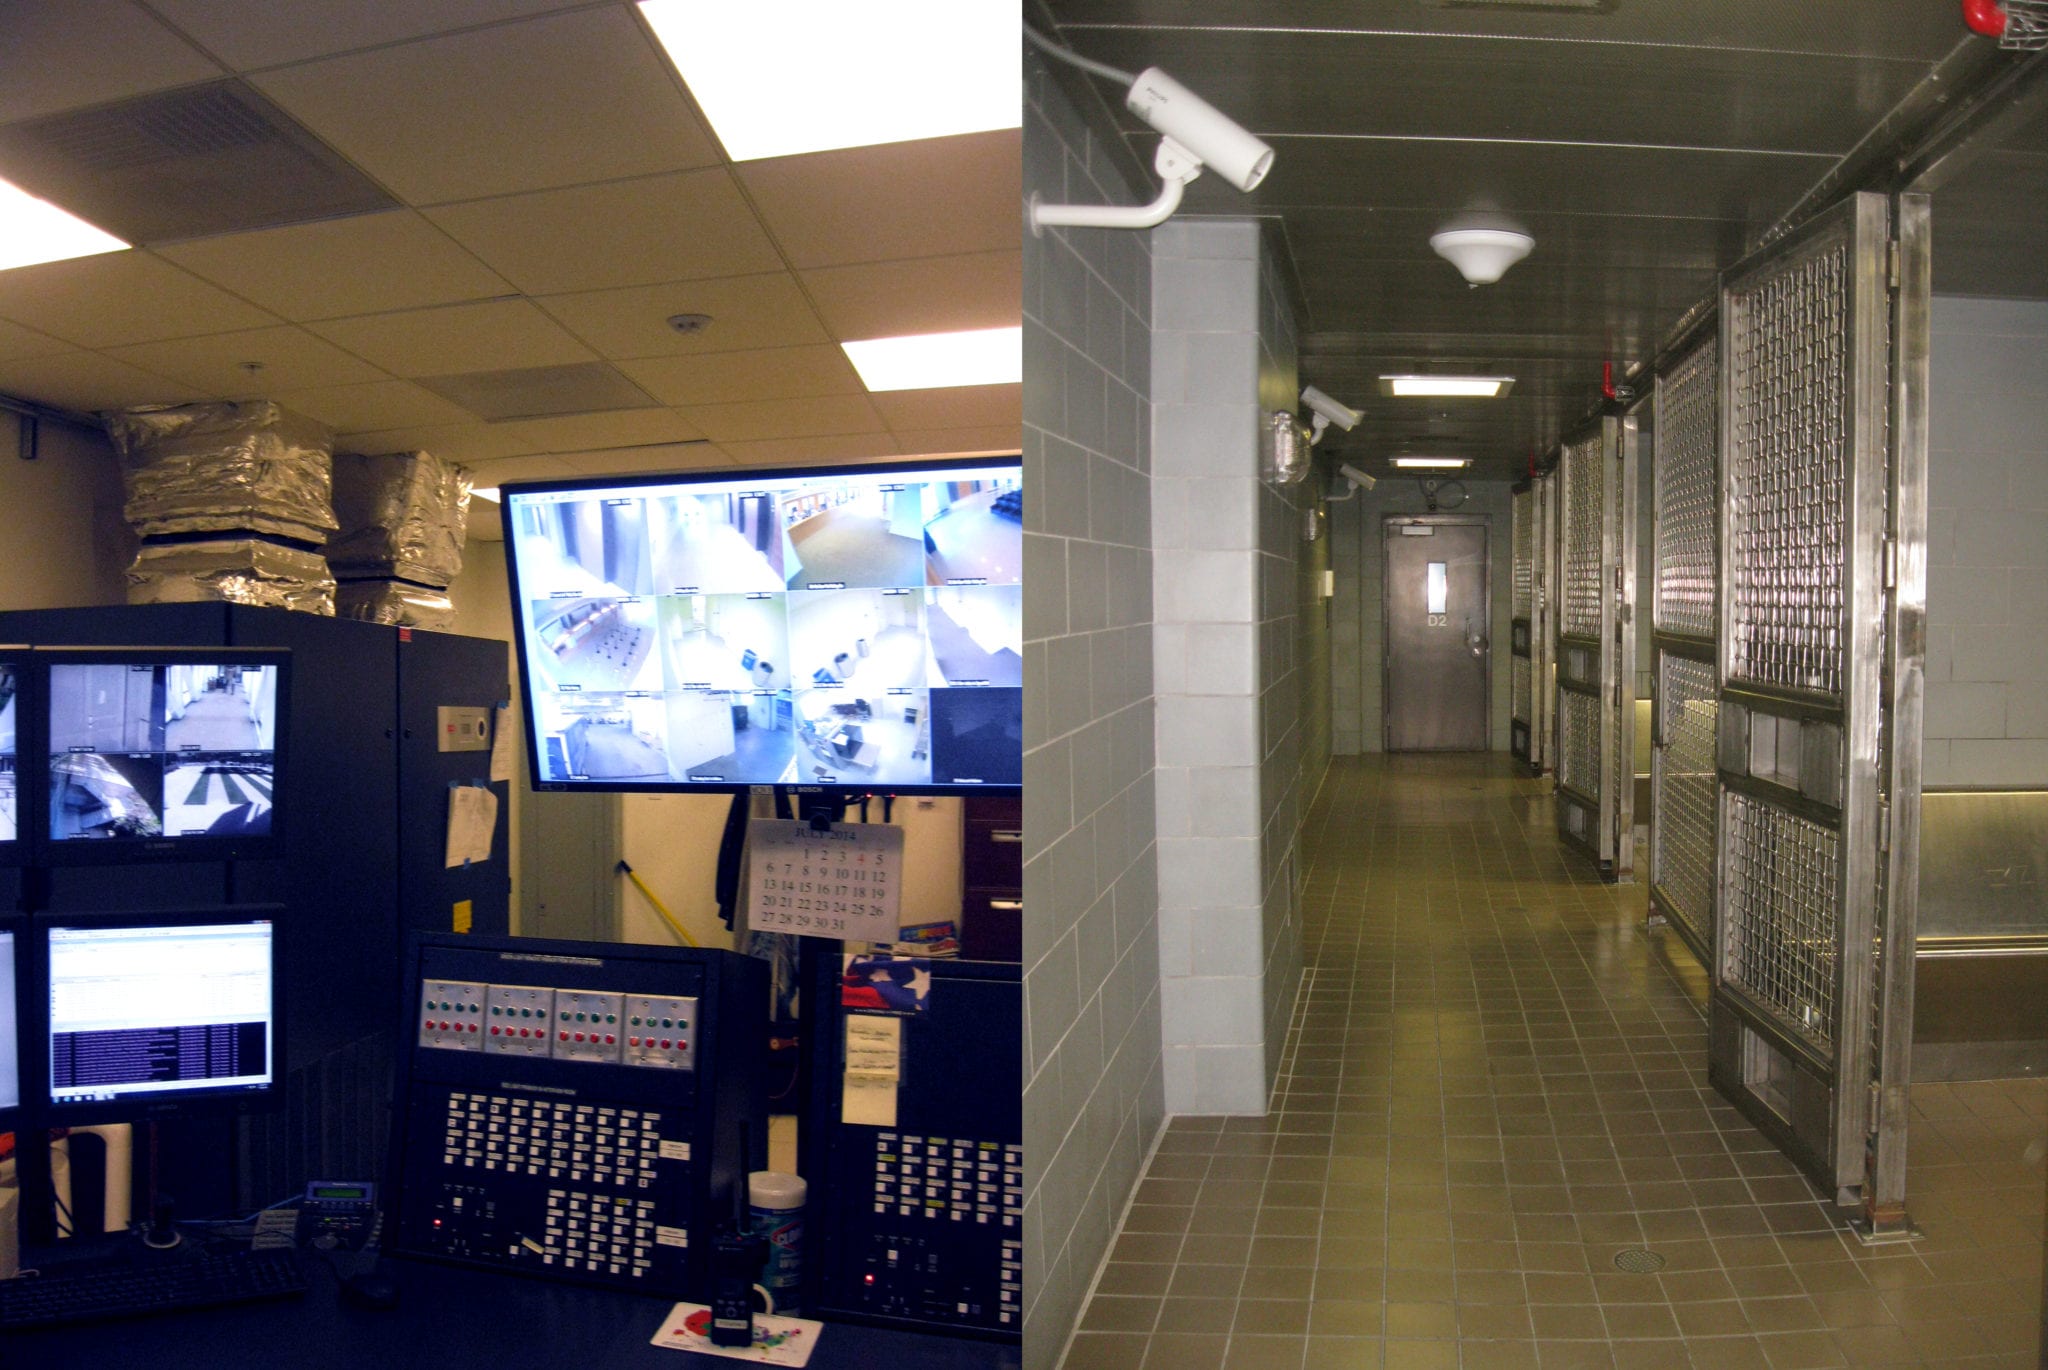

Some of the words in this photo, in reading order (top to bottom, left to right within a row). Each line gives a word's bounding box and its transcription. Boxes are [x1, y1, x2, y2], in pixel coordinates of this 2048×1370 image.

[1428, 615, 1447, 627] D2
[795, 827, 824, 839] JULY
[829, 830, 856, 841] 2014
[803, 848, 810, 860] 1
[820, 849, 829, 861] 2
[839, 850, 847, 863] 3
[857, 853, 865, 865] 4
[875, 854, 884, 866] 5
[766, 862, 775, 873] 6
[784, 863, 793, 875] 7
[802, 865, 810, 876] 8
[819, 866, 828, 877] 9
[835, 868, 850, 880] 10
[853, 869, 867, 881] 11
[872, 871, 886, 883] 12
[764, 878, 777, 890] 13
[781, 880, 795, 891] 14
[799, 881, 812, 893] 15
[817, 883, 830, 895] 16
[835, 885, 849, 896] 17
[853, 887, 866, 898] 18
[871, 888, 886, 900] 19
[762, 895, 777, 906] 20
[779, 896, 793, 908] 21
[796, 898, 811, 911] 22
[814, 900, 829, 912] 23
[832, 901, 847, 913] 24
[850, 903, 865, 915] 25
[868, 905, 884, 917] 26
[761, 911, 776, 923] 27
[778, 913, 793, 925] 28
[795, 914, 811, 927] 29
[814, 916, 829, 929] 30
[831, 918, 845, 930] 31
